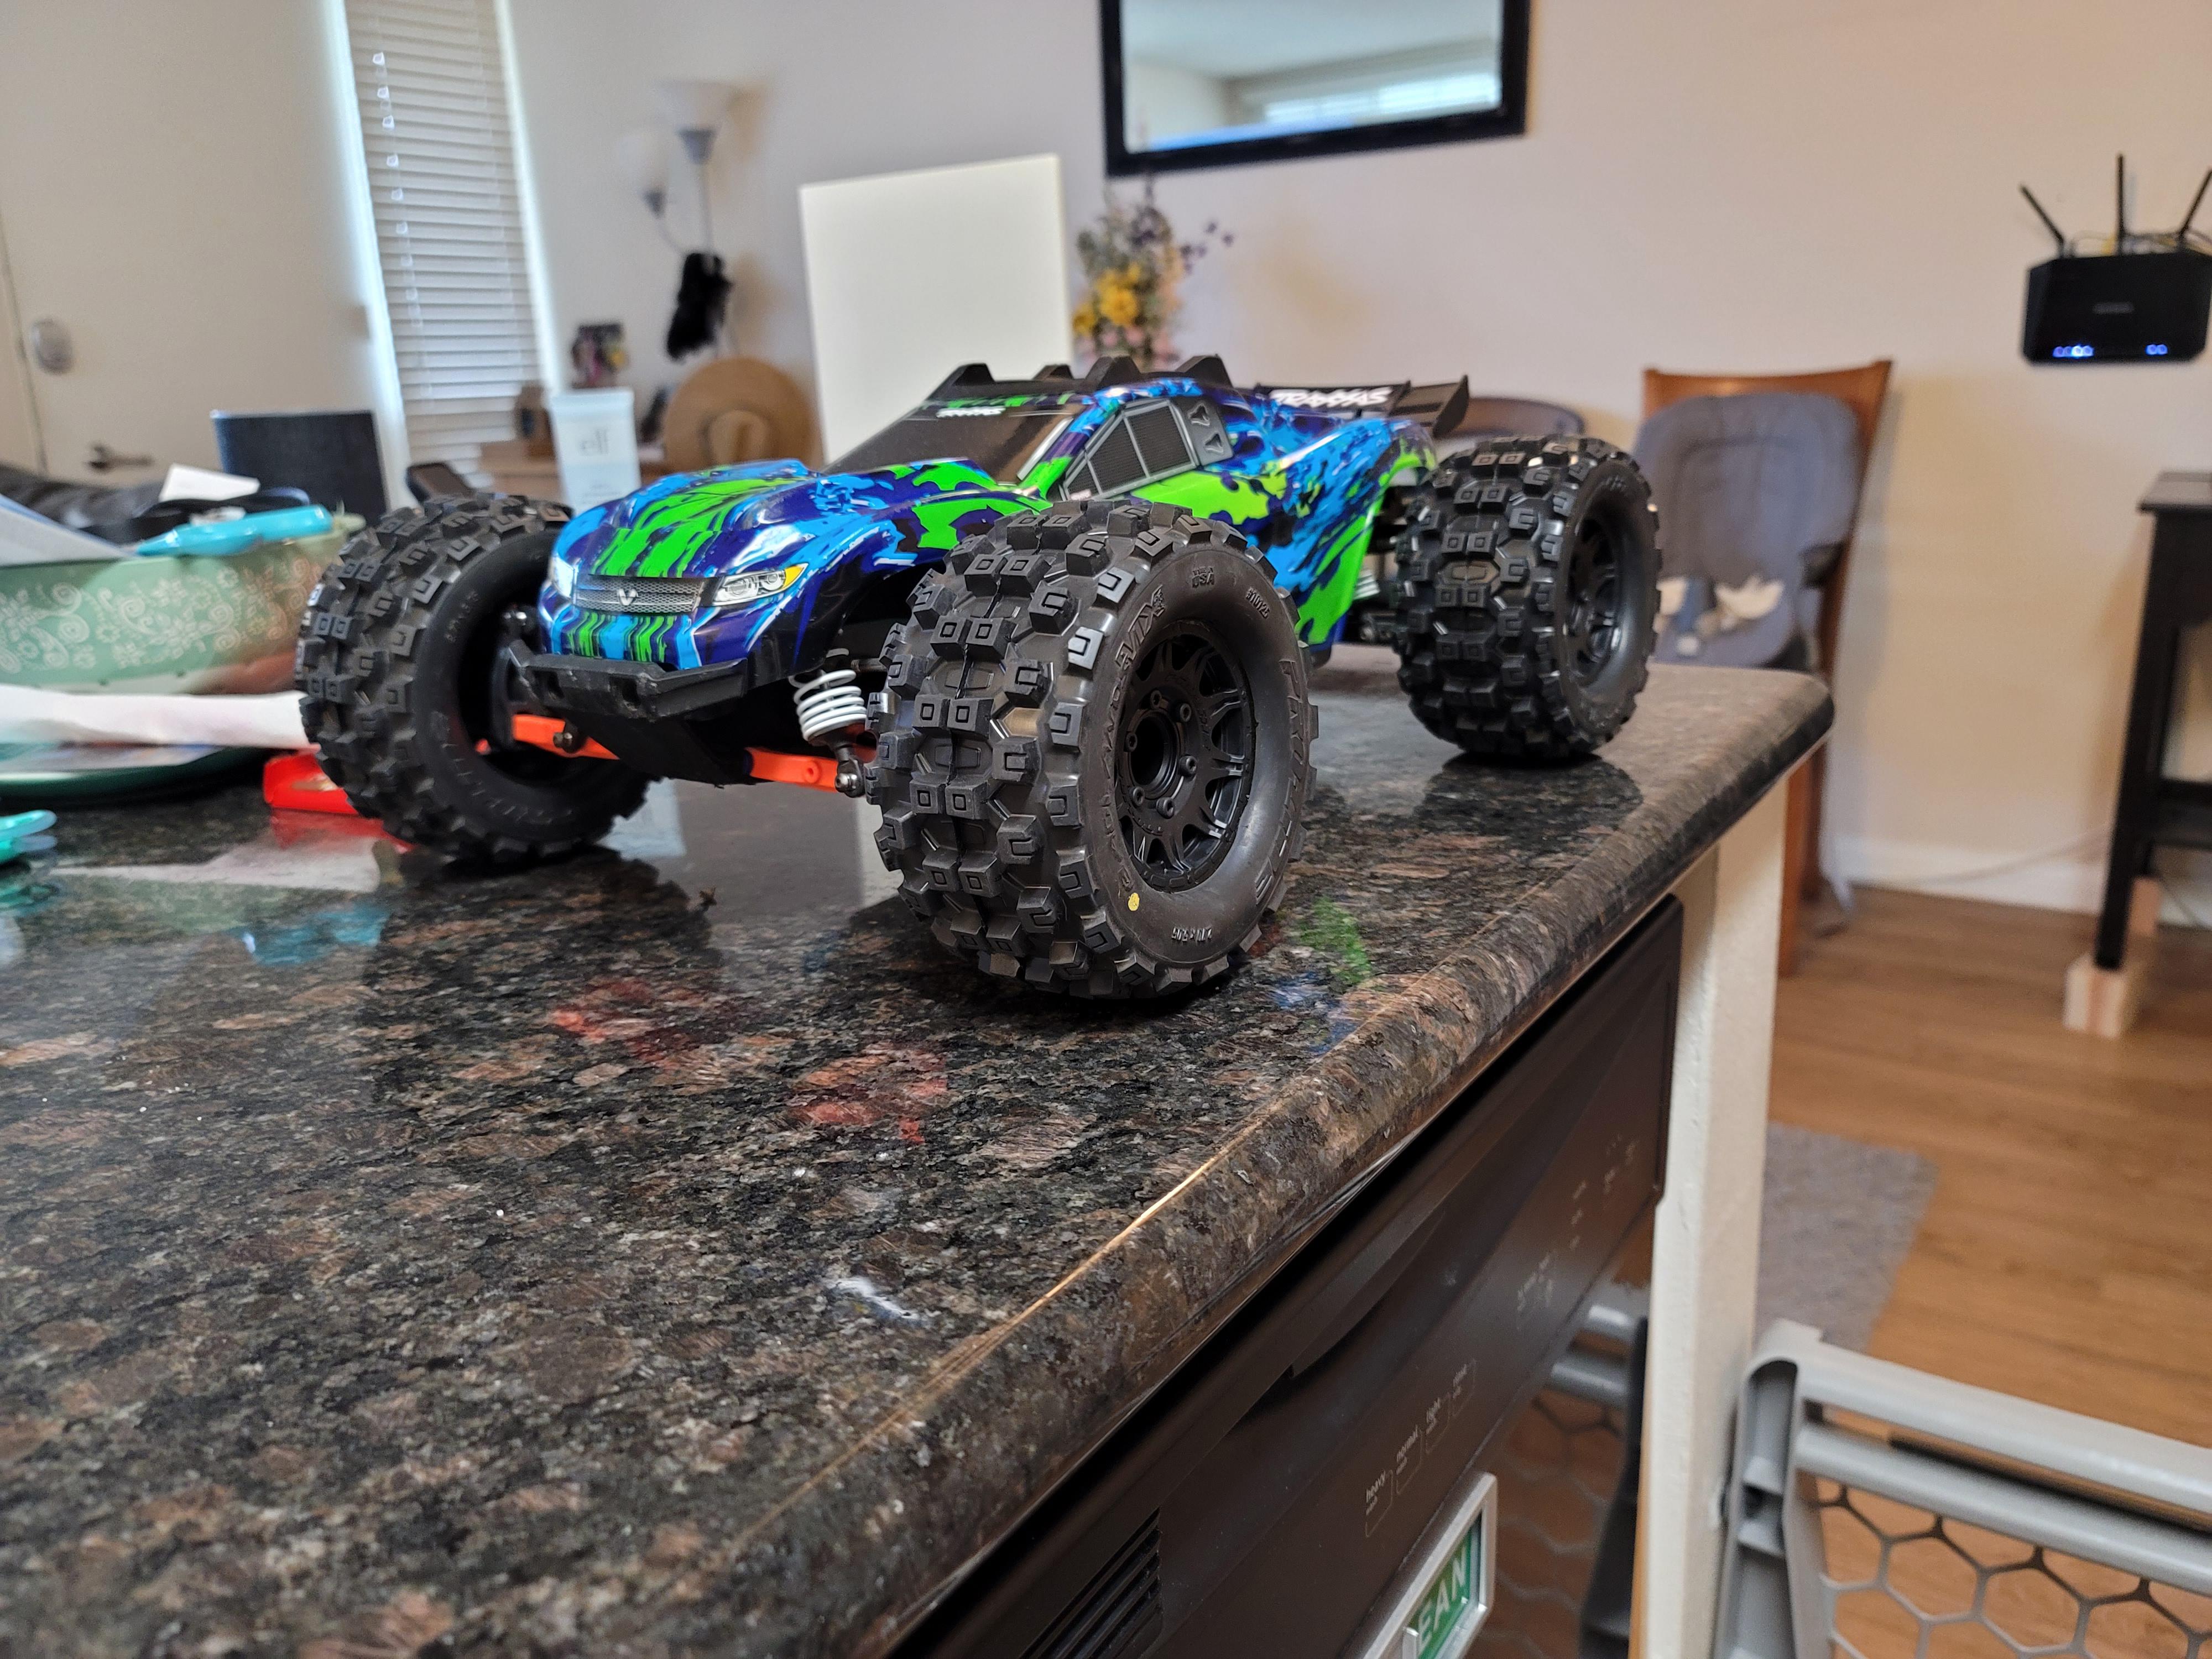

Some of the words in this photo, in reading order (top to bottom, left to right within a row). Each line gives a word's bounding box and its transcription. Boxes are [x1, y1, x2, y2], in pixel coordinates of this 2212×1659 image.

[1191, 572, 1215, 588] USA
[1246, 589, 1270, 619] #10125
[1366, 1469, 1386, 1503] heavy
